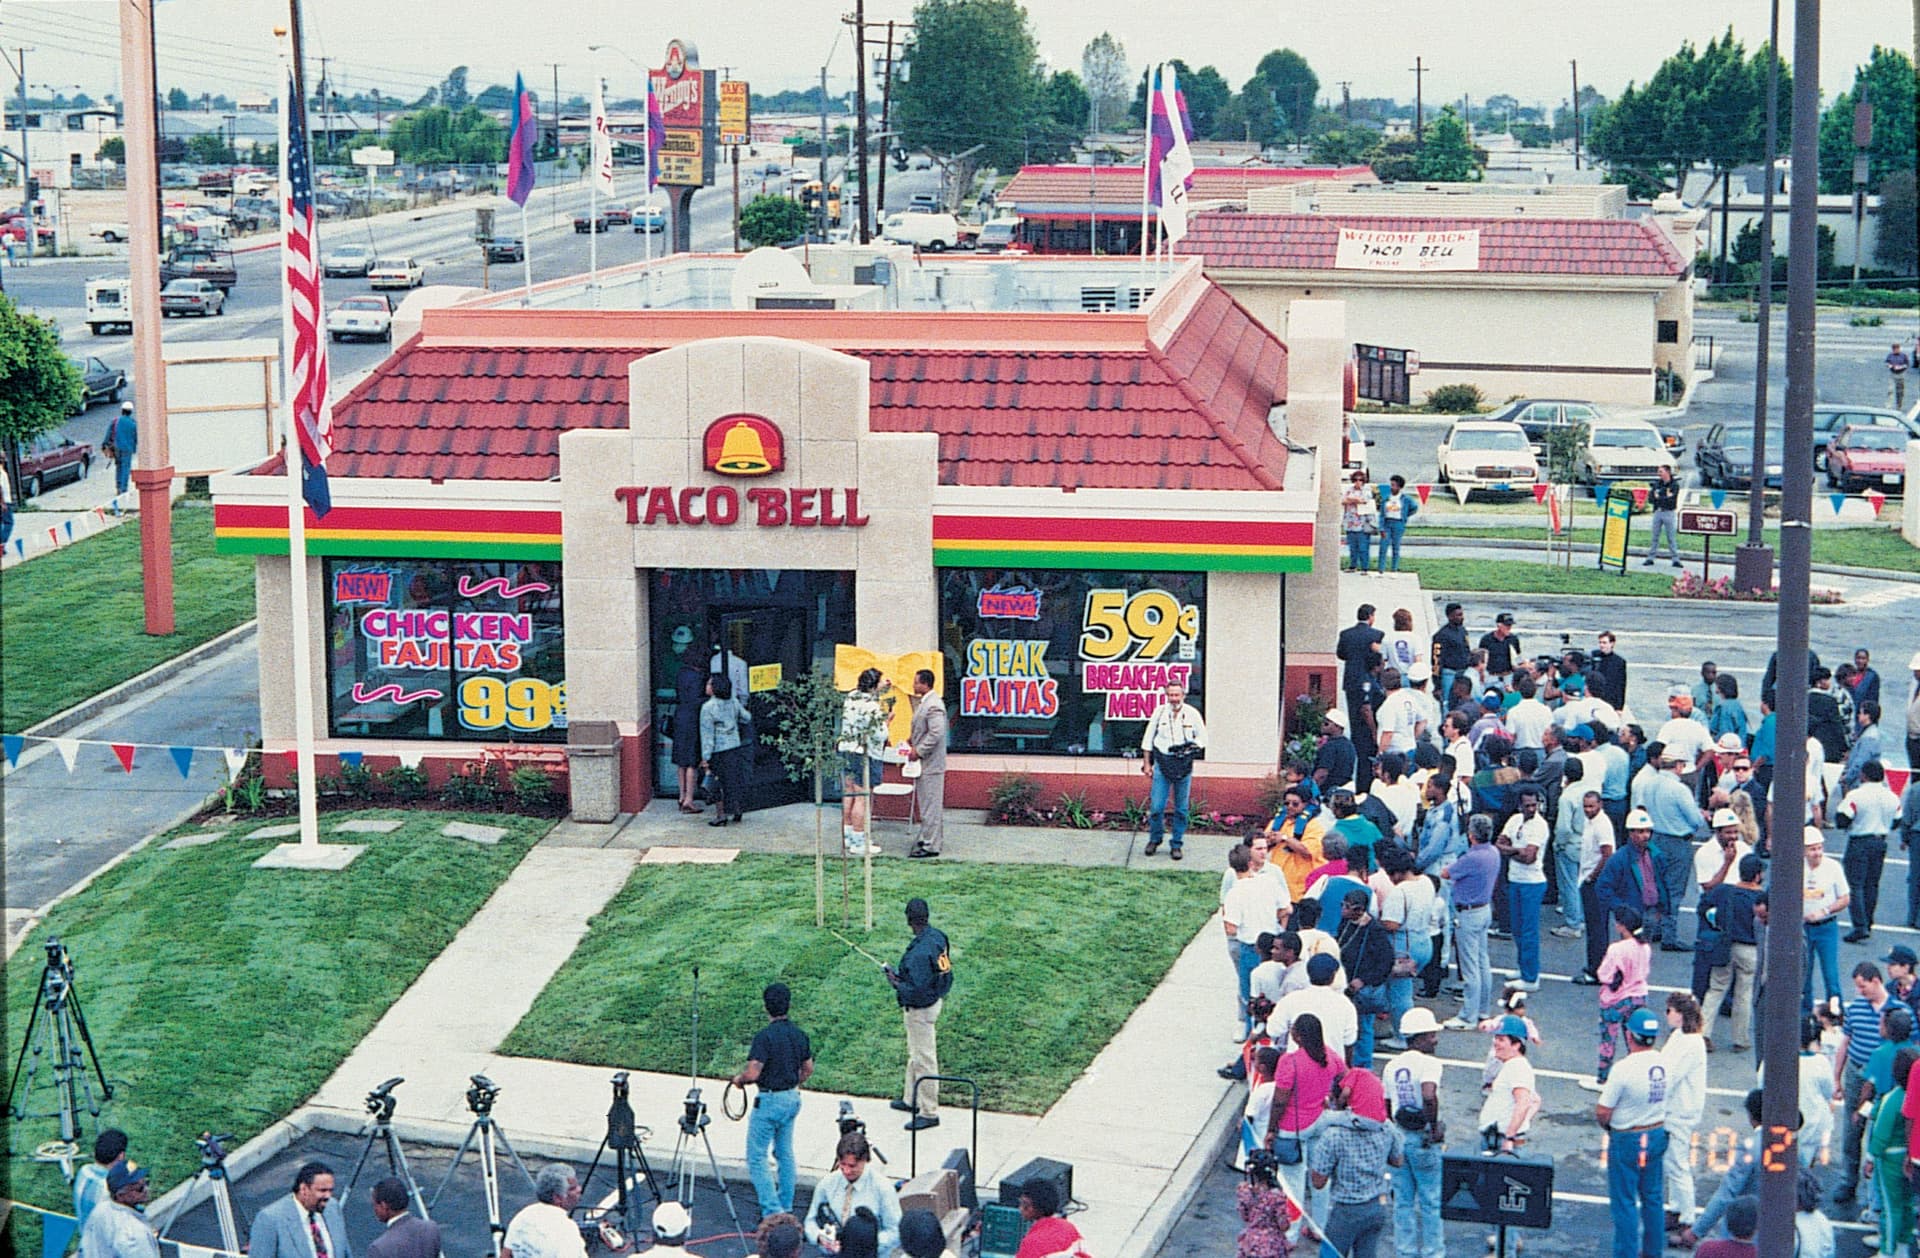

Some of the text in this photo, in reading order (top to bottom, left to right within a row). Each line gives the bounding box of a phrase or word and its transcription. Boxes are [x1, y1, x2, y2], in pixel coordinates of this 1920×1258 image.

[1344, 231, 1417, 244] WELCOME
[1362, 244, 1402, 257] TACO
[615, 485, 871, 527] TACO BELL
[341, 576, 386, 598] NEW!
[986, 599, 1034, 613] NEW!
[362, 610, 531, 642] CHICKEN
[380, 641, 520, 671] FAJITAS
[968, 640, 1048, 676] STEAK
[963, 679, 1058, 716] FAJITAS
[1108, 693, 1166, 718] MEN
